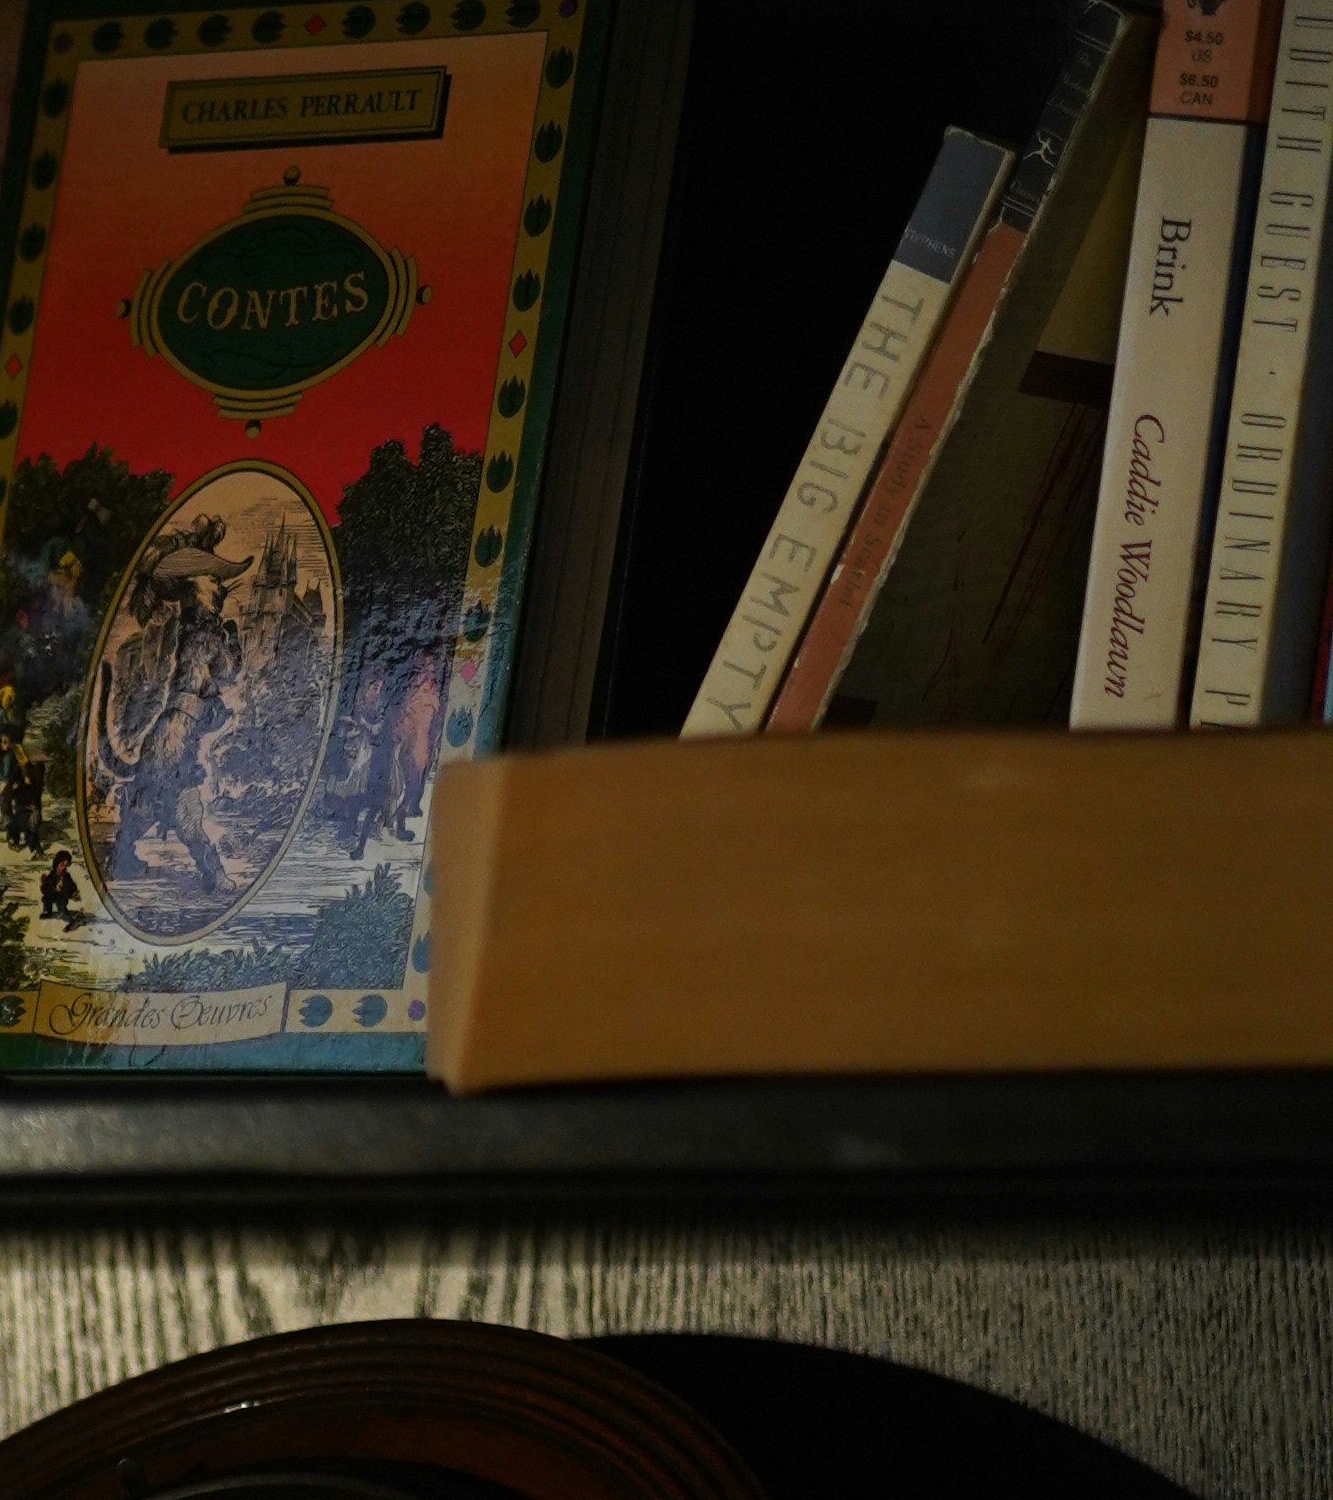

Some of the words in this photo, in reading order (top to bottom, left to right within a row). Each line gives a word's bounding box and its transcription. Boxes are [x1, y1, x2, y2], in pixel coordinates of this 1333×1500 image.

[181, 96, 289, 125] CHARLES
[299, 88, 422, 120] PERRAULT
[175, 268, 370, 332] CONTES
[1149, 216, 1192, 318] Brink
[1252, 188, 1314, 335] GUEST
[842, 294, 925, 402] THE
[795, 418, 865, 518] BIG
[1125, 413, 1166, 527] Caddie
[1210, 412, 1289, 657] ORDINARY
[706, 531, 818, 736] EMPTY
[1104, 538, 1155, 700] Woodlawn
